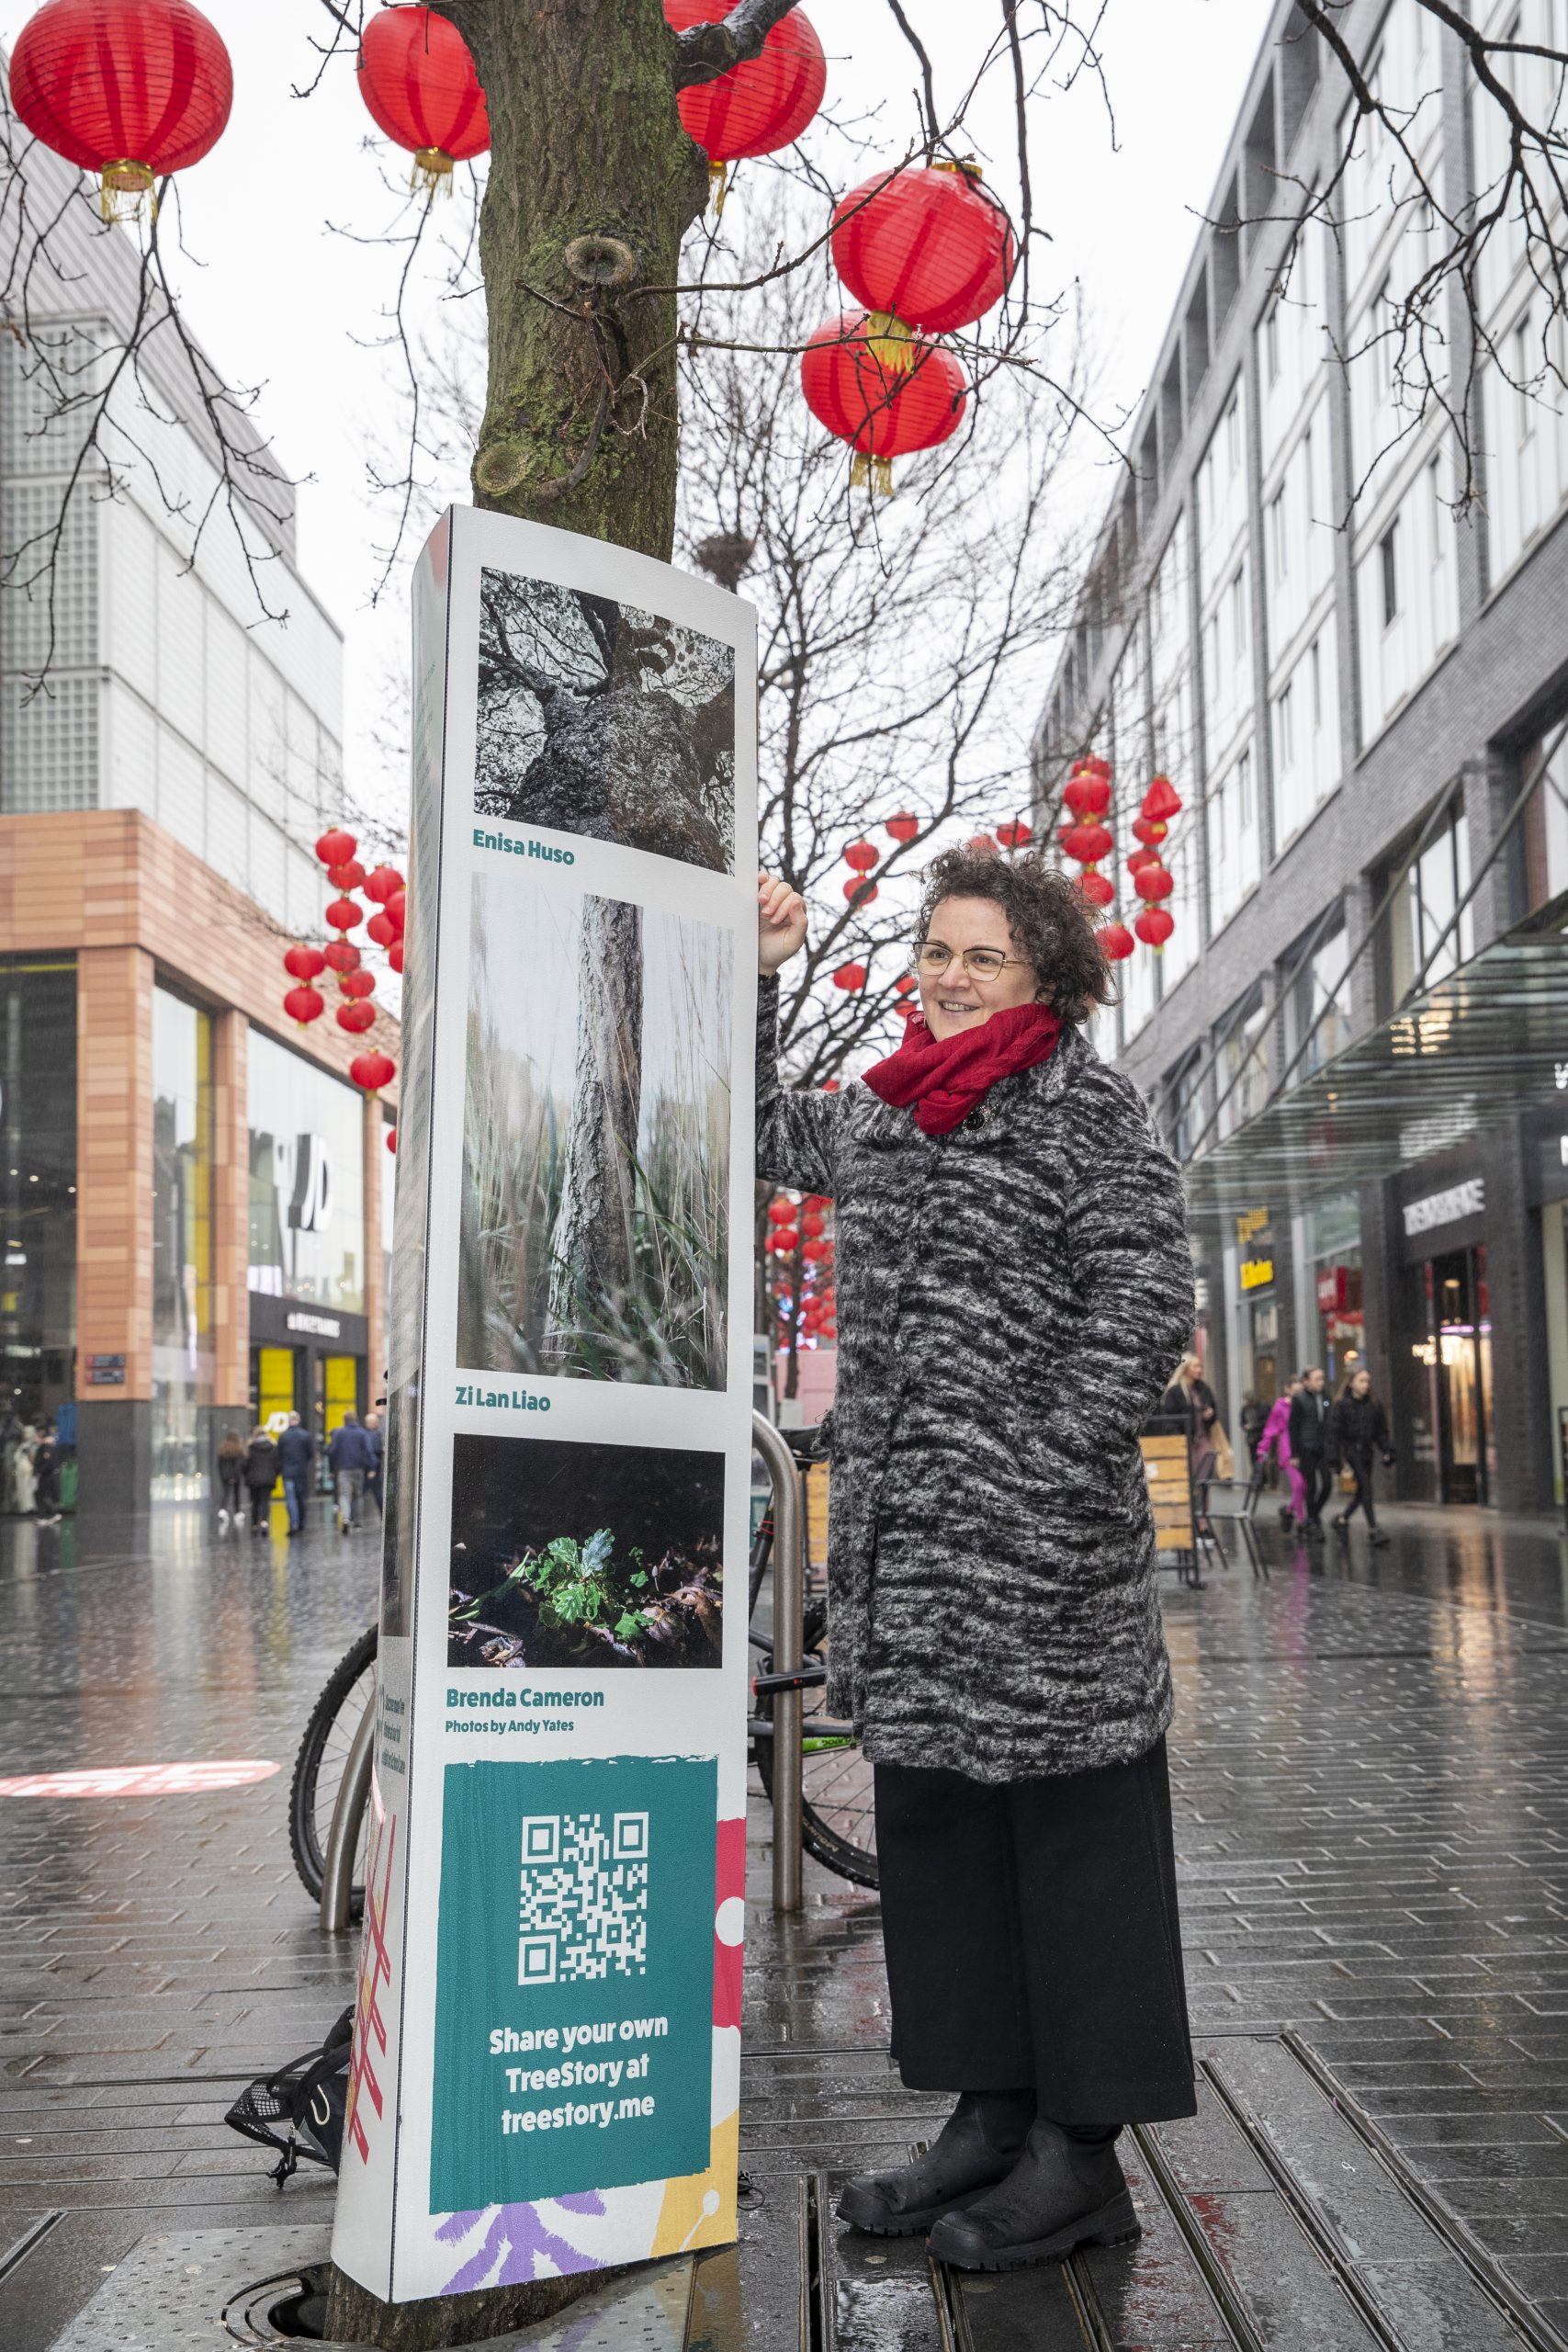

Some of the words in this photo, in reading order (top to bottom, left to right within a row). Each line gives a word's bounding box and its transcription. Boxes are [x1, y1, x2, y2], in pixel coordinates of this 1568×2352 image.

[473, 829, 525, 855] Enisa
[528, 840, 575, 865] Huso
[288, 1134, 333, 1232] JD
[455, 1385, 473, 1406] Zi
[476, 1387, 509, 1408] Lan
[512, 1389, 551, 1411] Liao
[446, 1687, 517, 1708] Brenda
[519, 1688, 604, 1707] Cameron
[446, 1720, 489, 1733] Photos
[490, 1719, 506, 1736] by
[508, 1719, 540, 1735] Andy
[542, 1719, 574, 1732] Yates
[489, 2027, 559, 2055] Share
[561, 2022, 616, 2053] your
[619, 2016, 669, 2041] own
[505, 2060, 625, 2094] TreeStory
[626, 2052, 650, 2079] at
[501, 2095, 655, 2135] treestory.me
